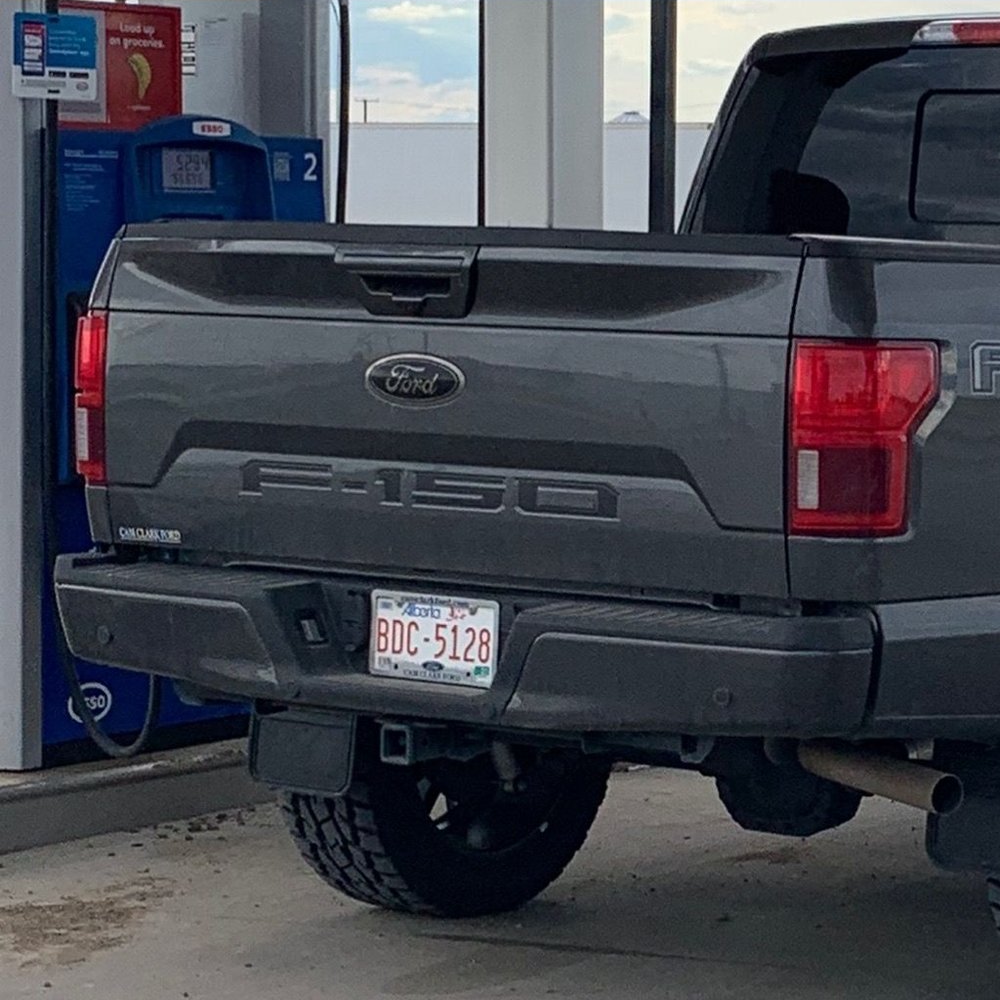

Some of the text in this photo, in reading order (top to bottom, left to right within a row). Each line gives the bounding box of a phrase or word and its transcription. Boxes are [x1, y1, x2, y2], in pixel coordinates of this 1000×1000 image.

[120, 21, 142, 34] Load
[303, 152, 318, 181] 2
[386, 364, 439, 395] Ford
[239, 459, 621, 521] F-150
[401, 603, 441, 620] Alberta
[376, 618, 491, 663] BDC-5128
